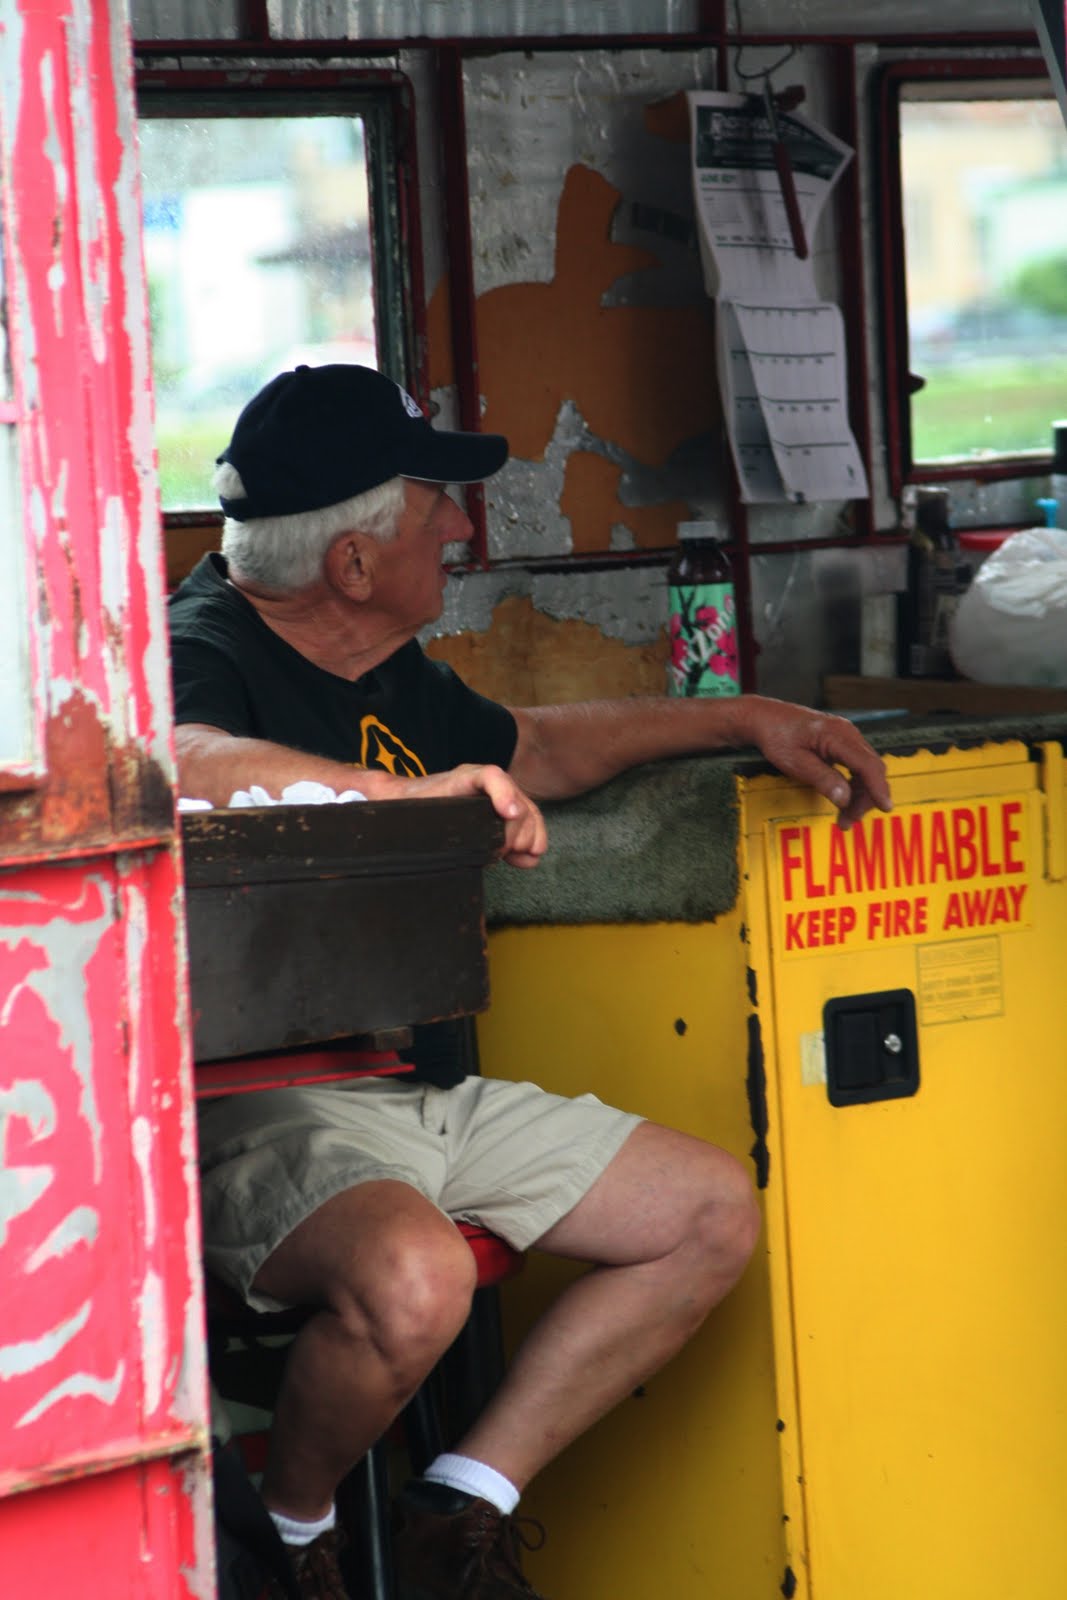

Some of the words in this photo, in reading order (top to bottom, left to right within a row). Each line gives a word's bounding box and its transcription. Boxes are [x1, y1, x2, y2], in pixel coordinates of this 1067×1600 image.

[780, 802, 1024, 902] FLAMMABLE
[785, 906, 857, 951] KEEP
[867, 897, 928, 941] FIRE
[942, 884, 1028, 931] AWAY
